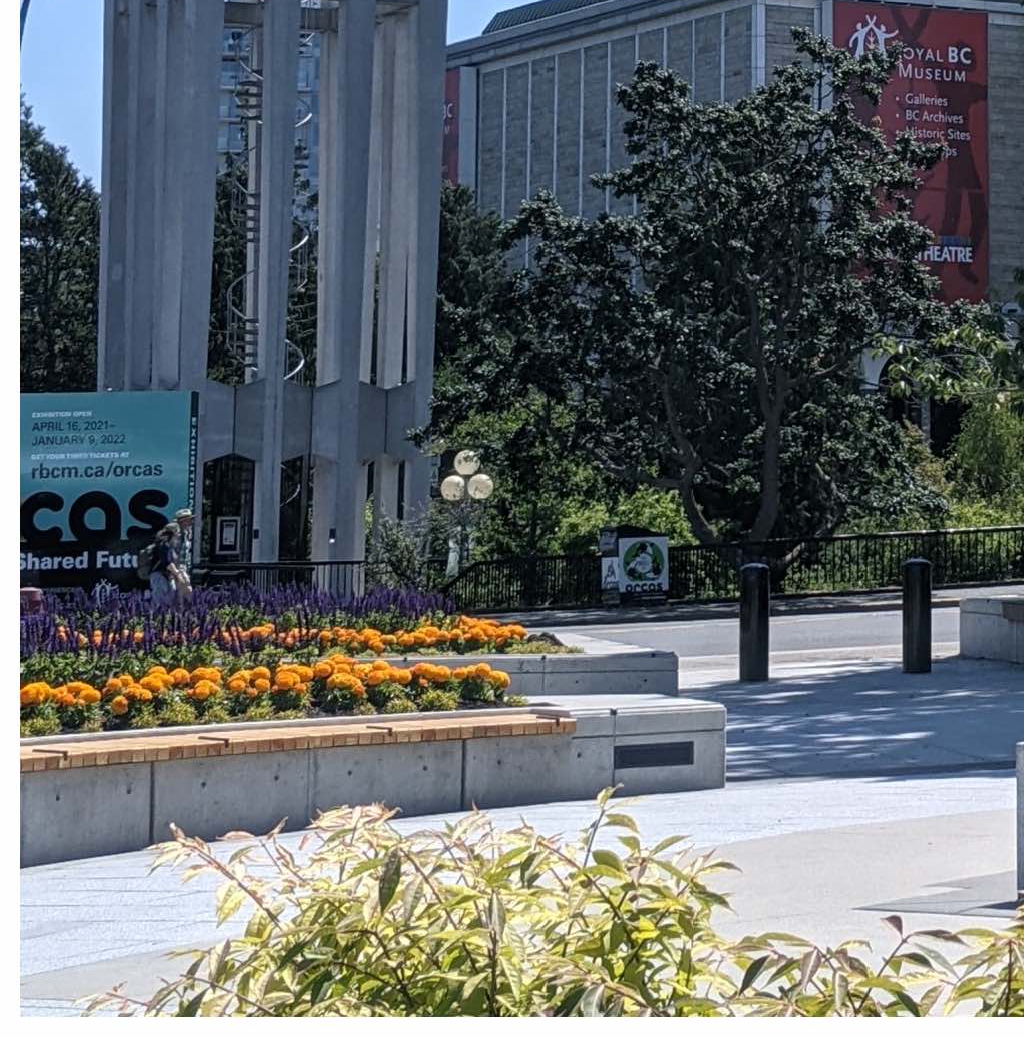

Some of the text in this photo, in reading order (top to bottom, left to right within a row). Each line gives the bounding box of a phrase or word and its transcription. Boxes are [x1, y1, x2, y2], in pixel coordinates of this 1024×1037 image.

[896, 46, 972, 64] OYAL BC
[899, 63, 966, 82] MUSEUM
[905, 93, 948, 107] Galleries
[905, 110, 964, 124] BC Archives
[947, 128, 971, 141] Sites
[32, 422, 64, 432] APRIL
[67, 422, 81, 432] 16,
[32, 434, 126, 446] JANUARY 9, 2022
[31, 461, 163, 480] rbcm.ca/orcas
